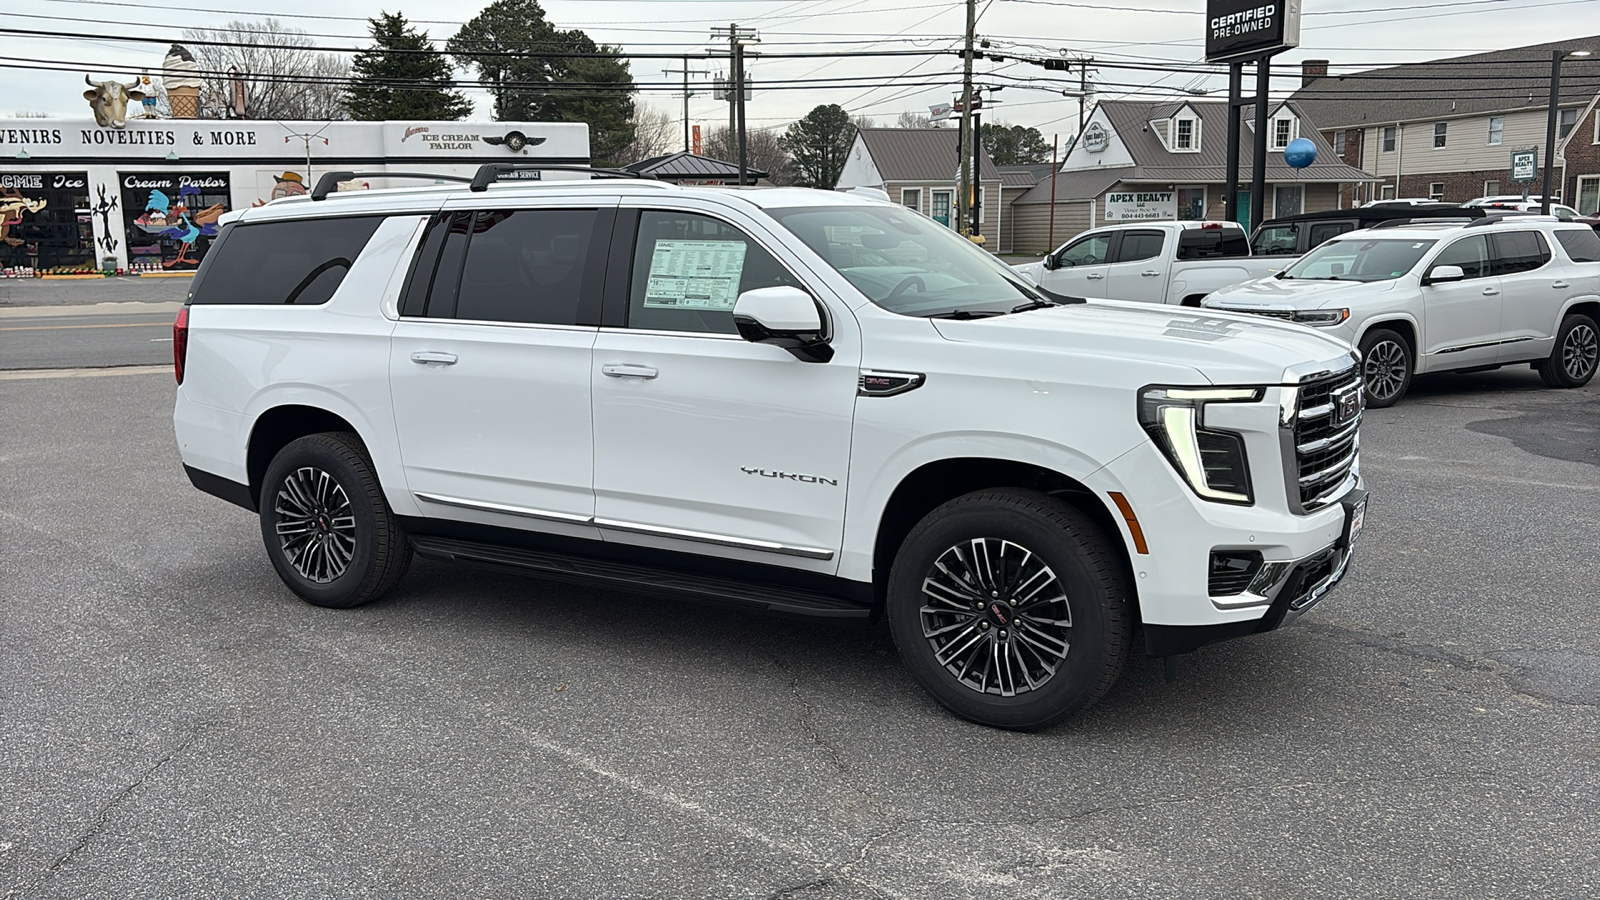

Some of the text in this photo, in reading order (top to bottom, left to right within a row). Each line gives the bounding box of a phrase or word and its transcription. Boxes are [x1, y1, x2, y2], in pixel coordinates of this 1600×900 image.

[1211, 4, 1275, 29] CERTIFIED
[1213, 17, 1271, 40] PRE-OWNED
[81, 130, 175, 145] NOVELTIES
[193, 131, 204, 145] &
[210, 131, 257, 145] MORE
[422, 134, 480, 142] ICE CREAM
[429, 142, 473, 150] PARLOR
[0, 174, 85, 189] CME Ice
[124, 175, 227, 188] Cream Parlor
[519, 171, 540, 179] SERVICE
[1109, 192, 1173, 203] APEX REALTY
[865, 377, 890, 385] GMC
[741, 465, 838, 486] YUKON
